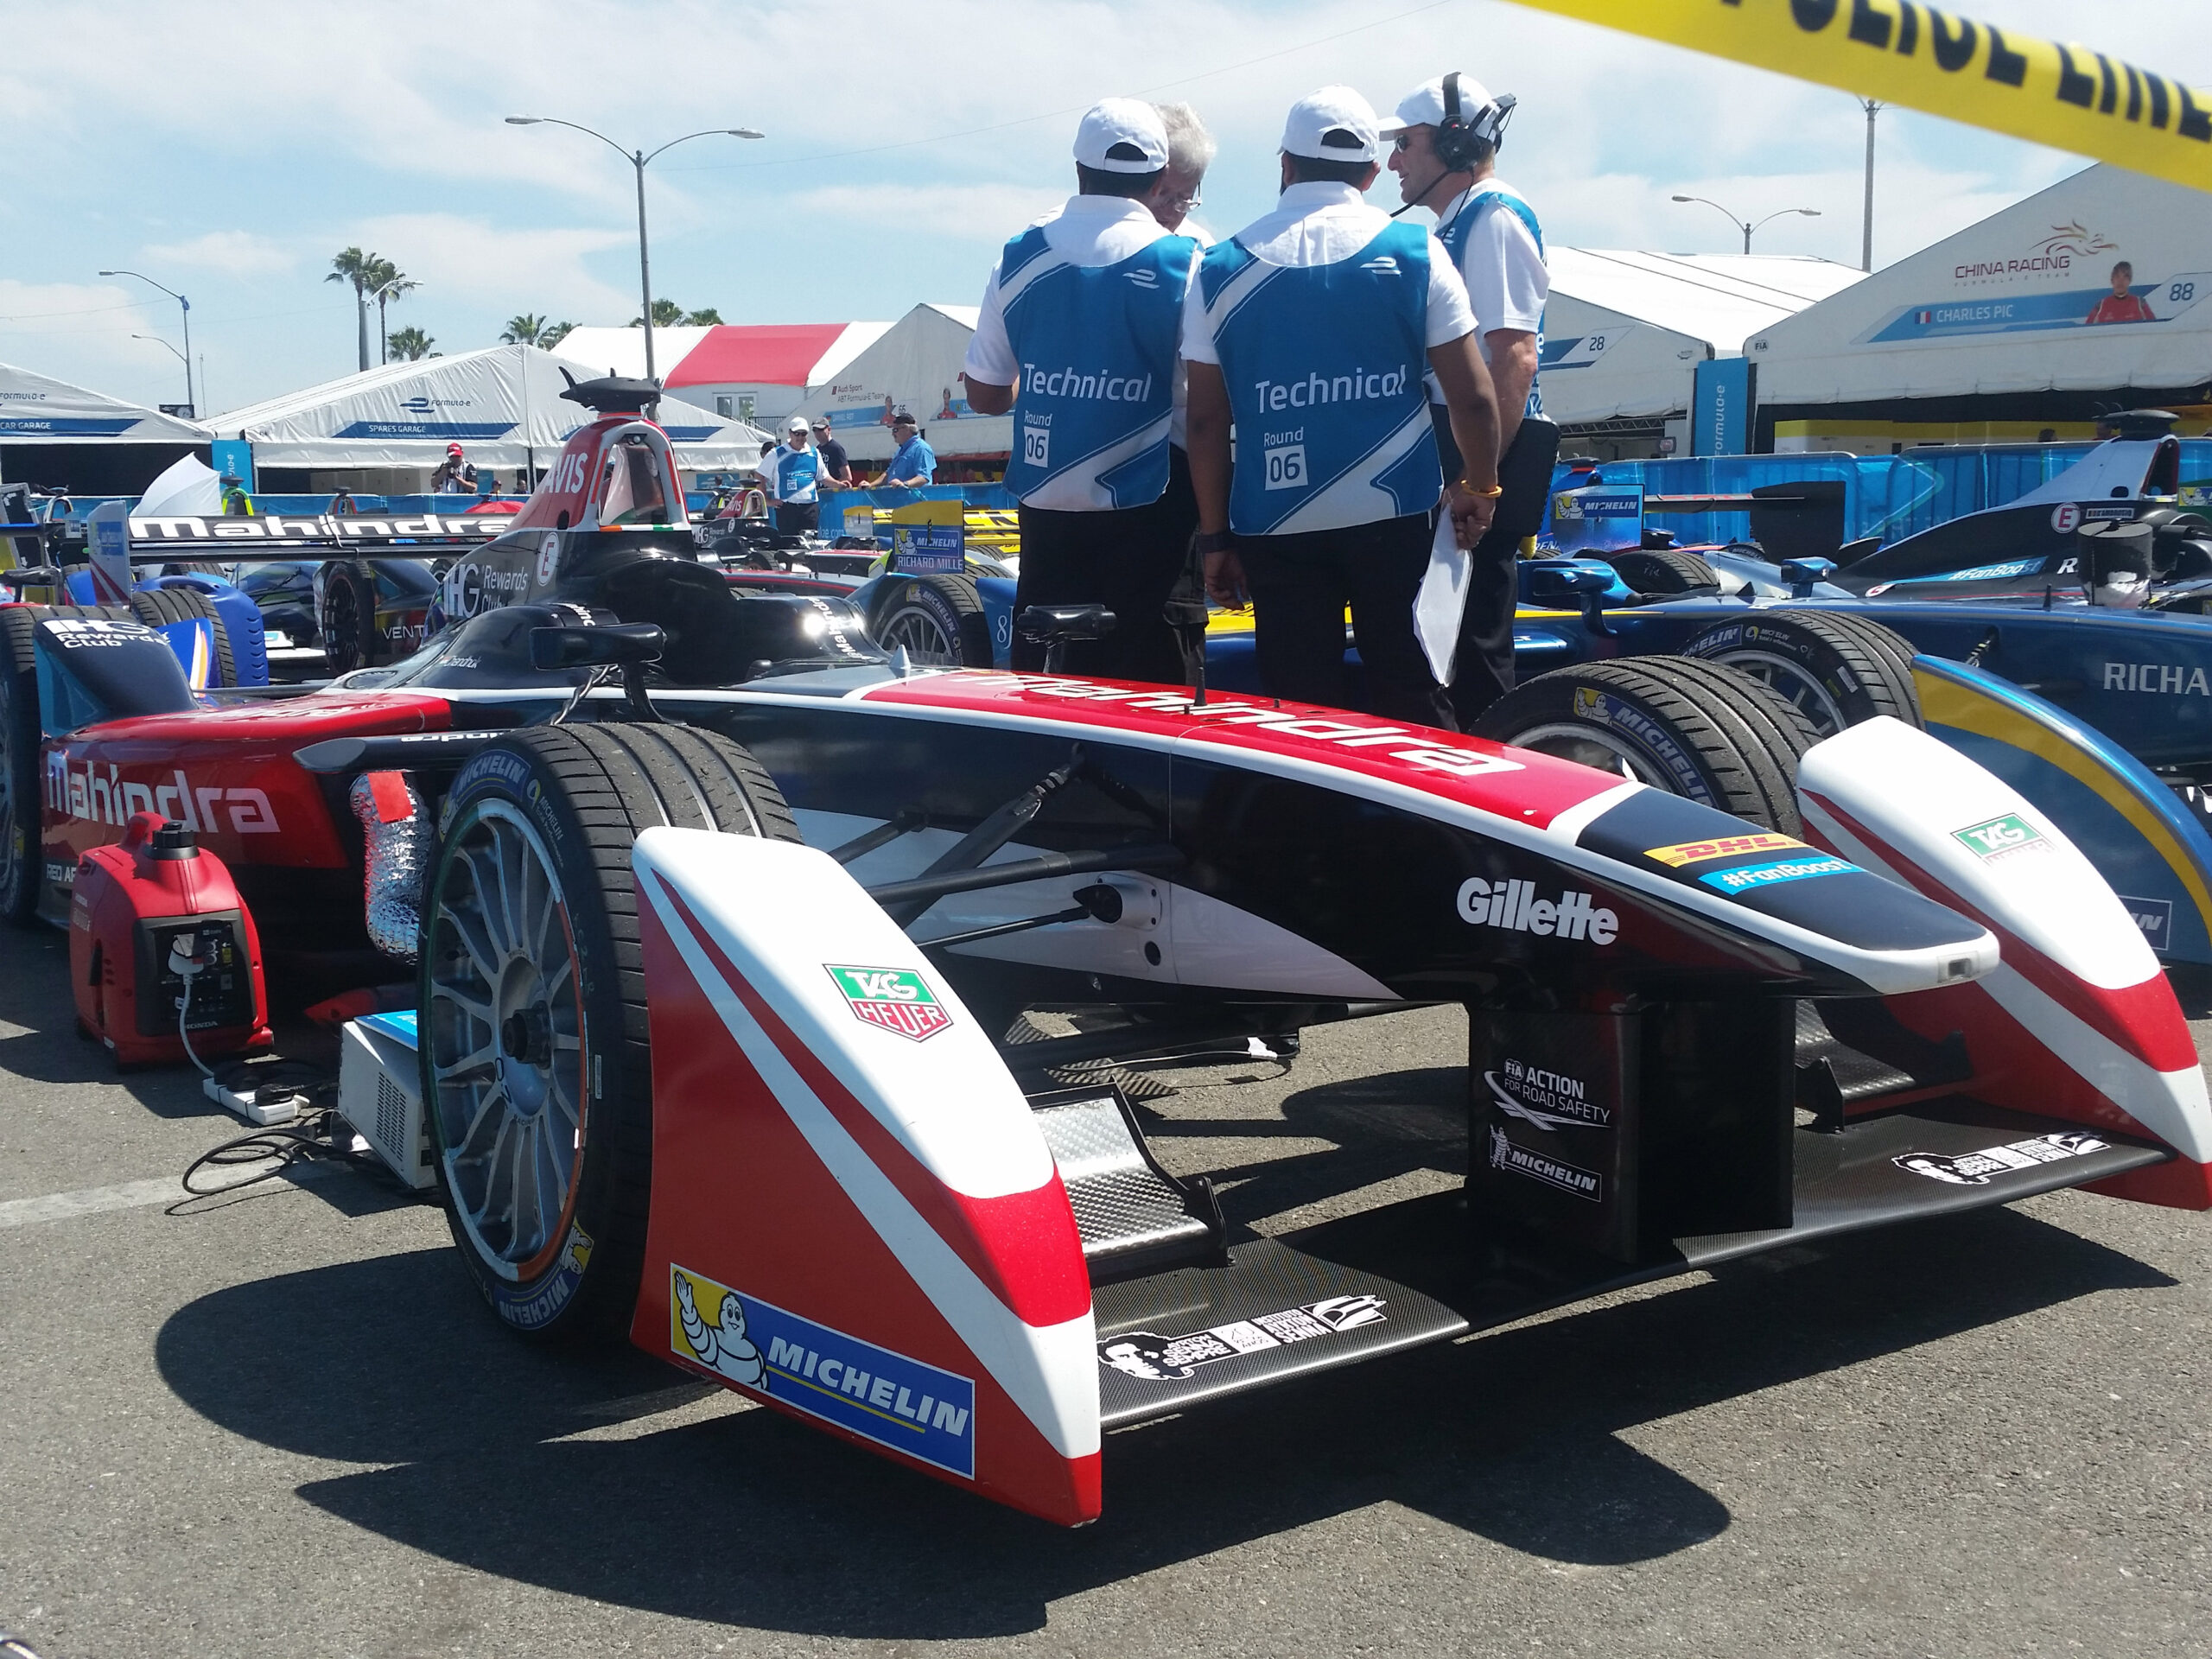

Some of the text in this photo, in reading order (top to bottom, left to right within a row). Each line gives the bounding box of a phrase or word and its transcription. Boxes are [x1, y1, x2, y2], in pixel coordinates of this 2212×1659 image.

[1955, 255, 2070, 279] CHINA RACING
[2170, 283, 2195, 302] 88
[1936, 305, 2013, 322] CHARLES PIC
[1588, 336, 1605, 351] 28
[1024, 363, 1153, 403] Technical
[1255, 364, 1407, 414] Technical
[368, 424, 397, 433] SPARES
[1024, 410, 1053, 427] Round
[1027, 434, 1046, 460] 06
[1264, 427, 1304, 447] Round
[543, 452, 588, 494] AVIS
[1270, 452, 1301, 483] 06
[1585, 500, 1638, 511] MICHELIN
[129, 514, 512, 538] mahindra
[897, 556, 963, 570] RICHARD MILLE
[1948, 561, 2041, 581] #FanBoost
[483, 564, 528, 591] Rewards
[921, 590, 957, 633] MICHELIN
[43, 619, 156, 635] IHG
[54, 631, 170, 646] Rewards
[62, 639, 123, 649] Club
[2103, 662, 2211, 696] RICHA
[456, 755, 526, 795] MICHELIN
[47, 750, 282, 834] mahindra
[537, 796, 564, 841] MICHELIN
[1675, 837, 1787, 859] DHL
[1967, 822, 2025, 851] TAG
[47, 864, 62, 881] RED
[1721, 858, 1853, 887] #FanBoost
[1456, 876, 1619, 946] Gillette
[844, 970, 919, 1001] TAG
[857, 1001, 945, 1036] HEUER
[1504, 1061, 1585, 1100] FIA ACTION
[1504, 1077, 1611, 1124] FOR ROAD SAFETY
[1511, 1150, 1597, 1191] MICHELIN
[499, 1273, 570, 1325] MICHELIN
[1274, 1321, 1333, 1344] SENNA
[1162, 1339, 1224, 1357] SENNA
[1162, 1347, 1232, 1367] SEMPRE
[767, 1336, 969, 1438] MICHELIN
